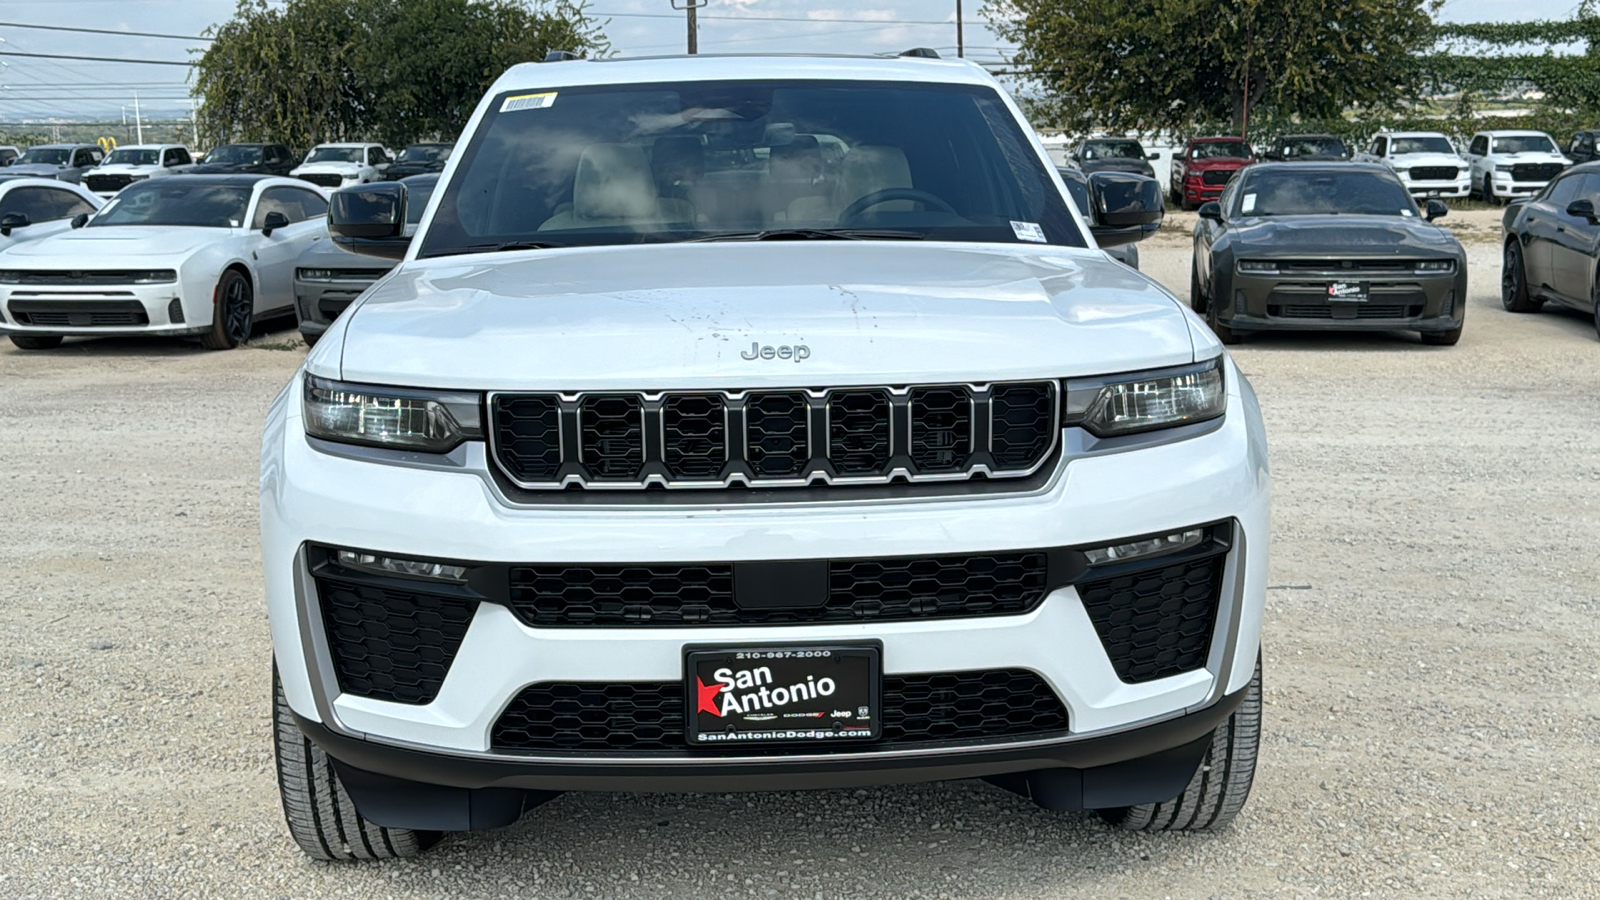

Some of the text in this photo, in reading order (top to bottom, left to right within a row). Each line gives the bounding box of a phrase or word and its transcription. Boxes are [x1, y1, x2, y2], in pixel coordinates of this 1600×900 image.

[740, 342, 811, 363] Jeep
[735, 650, 831, 660] 210-967-2000
[713, 666, 773, 692] San
[721, 675, 836, 717] Antonio
[830, 709, 852, 719] Jeep
[698, 729, 872, 741] SanAntonioDodge.com
